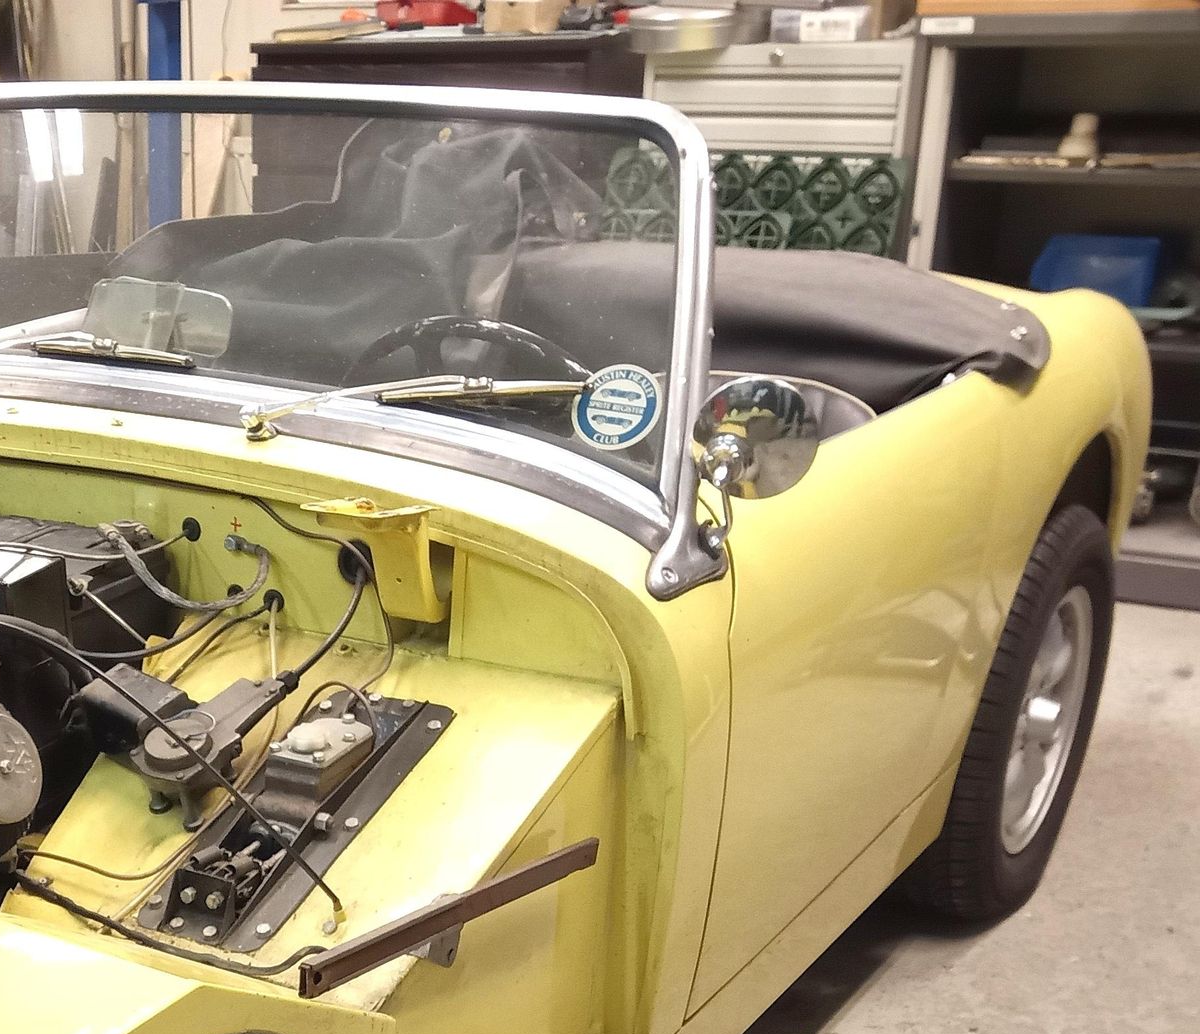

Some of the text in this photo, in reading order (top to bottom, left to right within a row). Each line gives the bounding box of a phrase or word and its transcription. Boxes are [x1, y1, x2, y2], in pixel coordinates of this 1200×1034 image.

[593, 370, 655, 398] AUSTIN HEALEY
[589, 400, 645, 415] SPRITE REGISTER
[592, 434, 620, 445] CLUB
